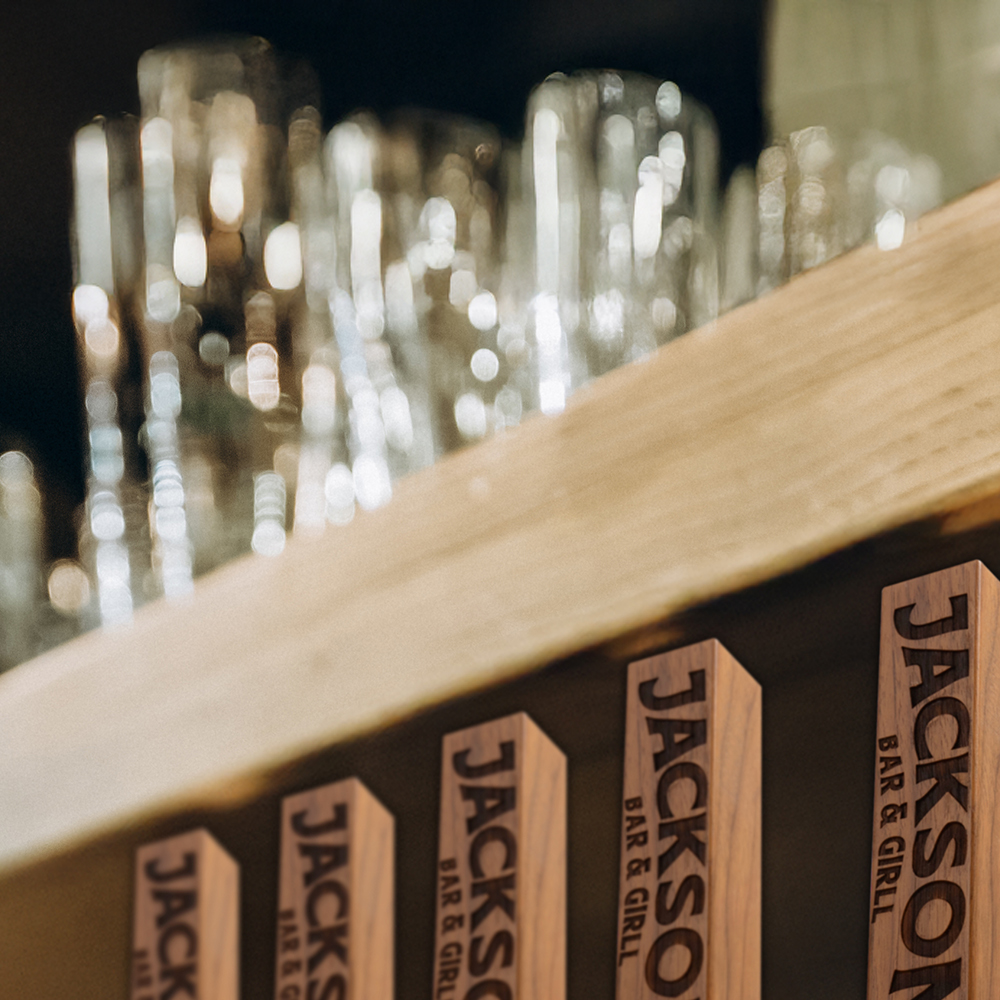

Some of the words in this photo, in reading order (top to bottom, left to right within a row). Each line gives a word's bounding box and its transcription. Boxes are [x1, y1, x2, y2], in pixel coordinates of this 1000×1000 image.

[878, 734, 905, 796] BAR
[624, 796, 649, 851] BAR
[880, 802, 908, 829] &
[439, 857, 462, 908] BAR
[626, 857, 651, 881] &
[871, 835, 906, 924] GIRLL
[441, 913, 464, 936] &
[618, 887, 650, 967] GIRLL
